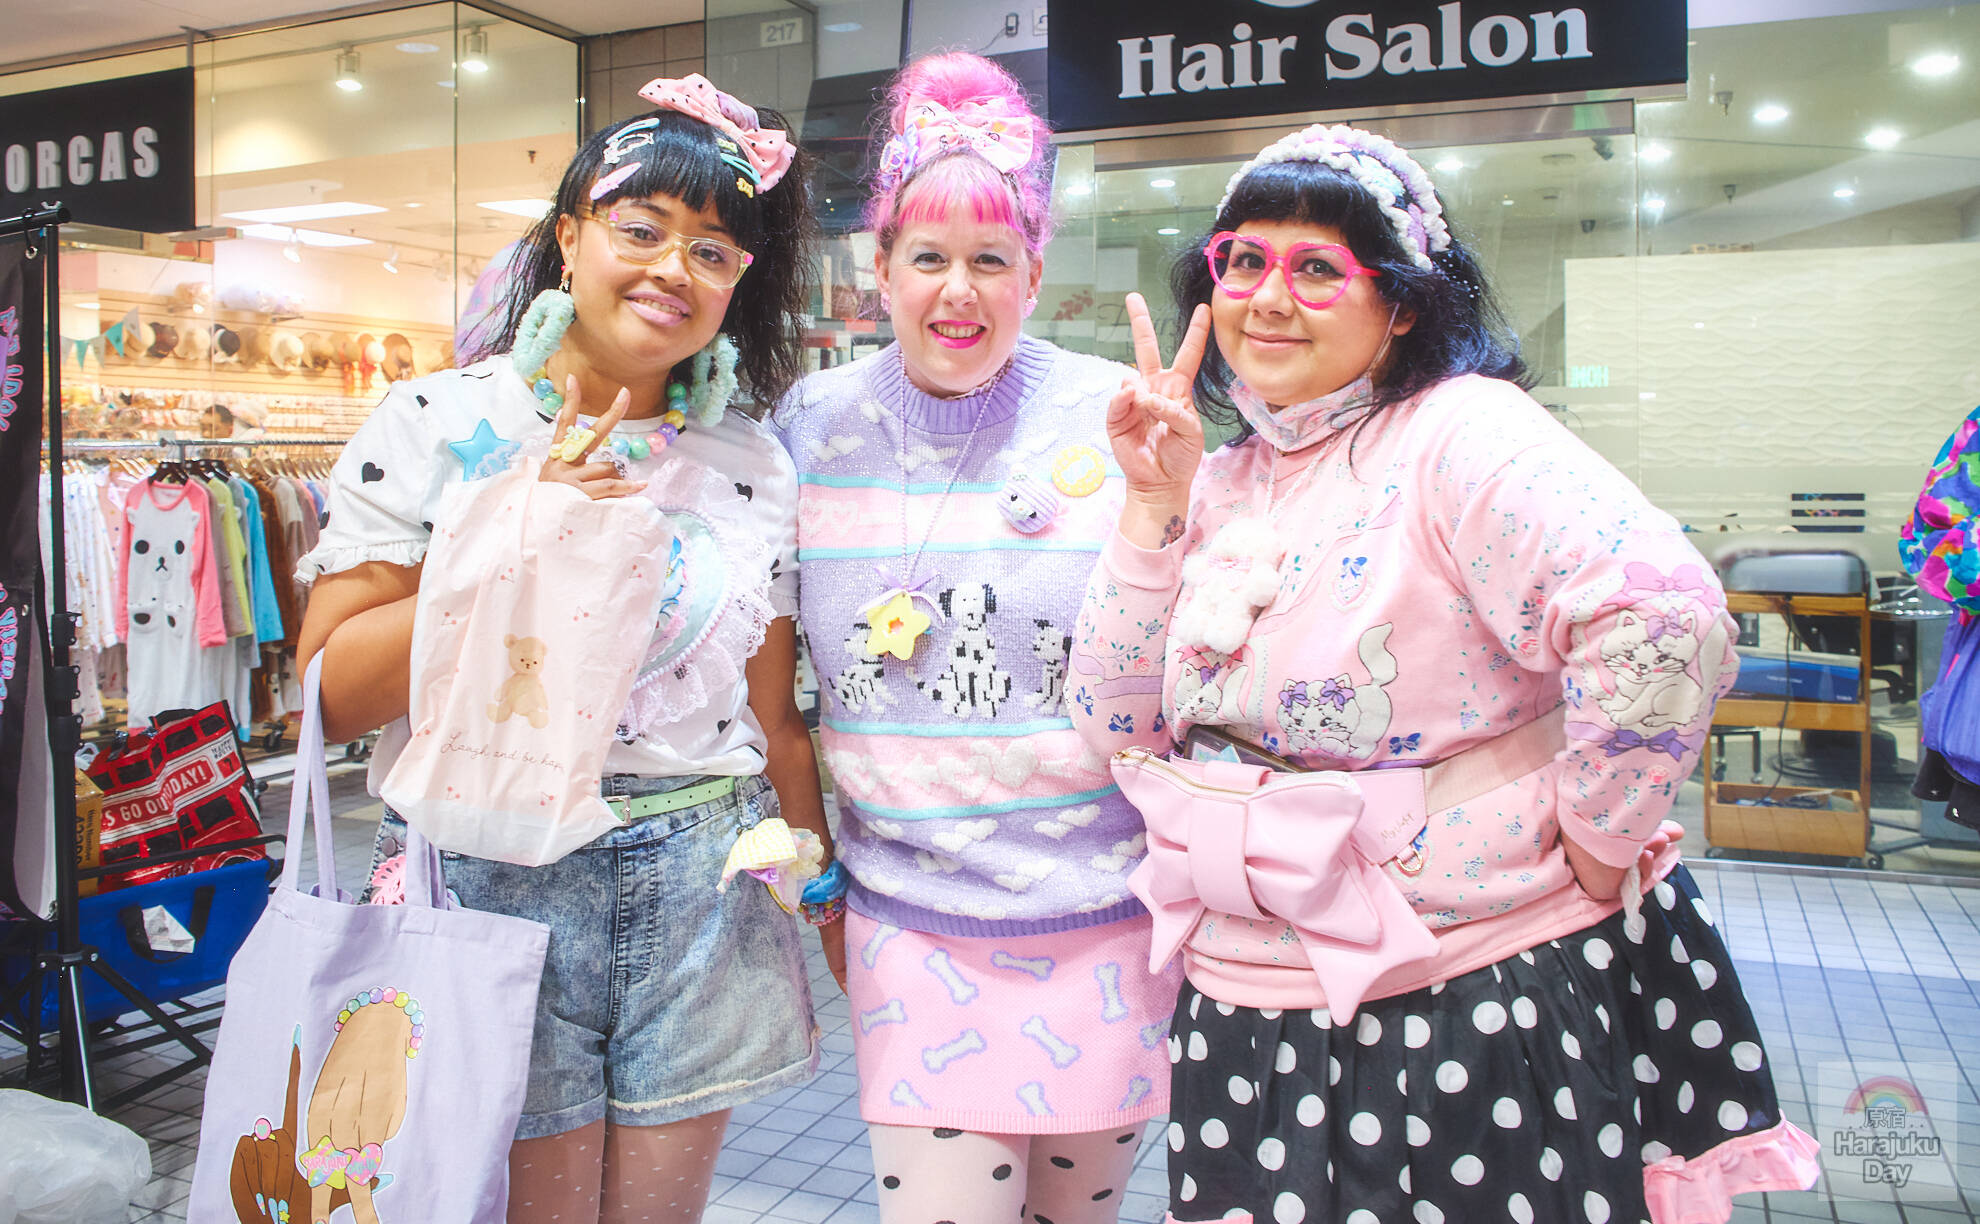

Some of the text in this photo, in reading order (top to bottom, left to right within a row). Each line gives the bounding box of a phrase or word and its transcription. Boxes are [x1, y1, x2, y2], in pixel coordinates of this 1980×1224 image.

[766, 22, 796, 42] 217
[1117, 1, 1593, 99] Hair Salon
[5, 126, 159, 193] ORCAS
[493, 750, 518, 760] and
[523, 752, 537, 762] be
[120, 803, 142, 821] GO
